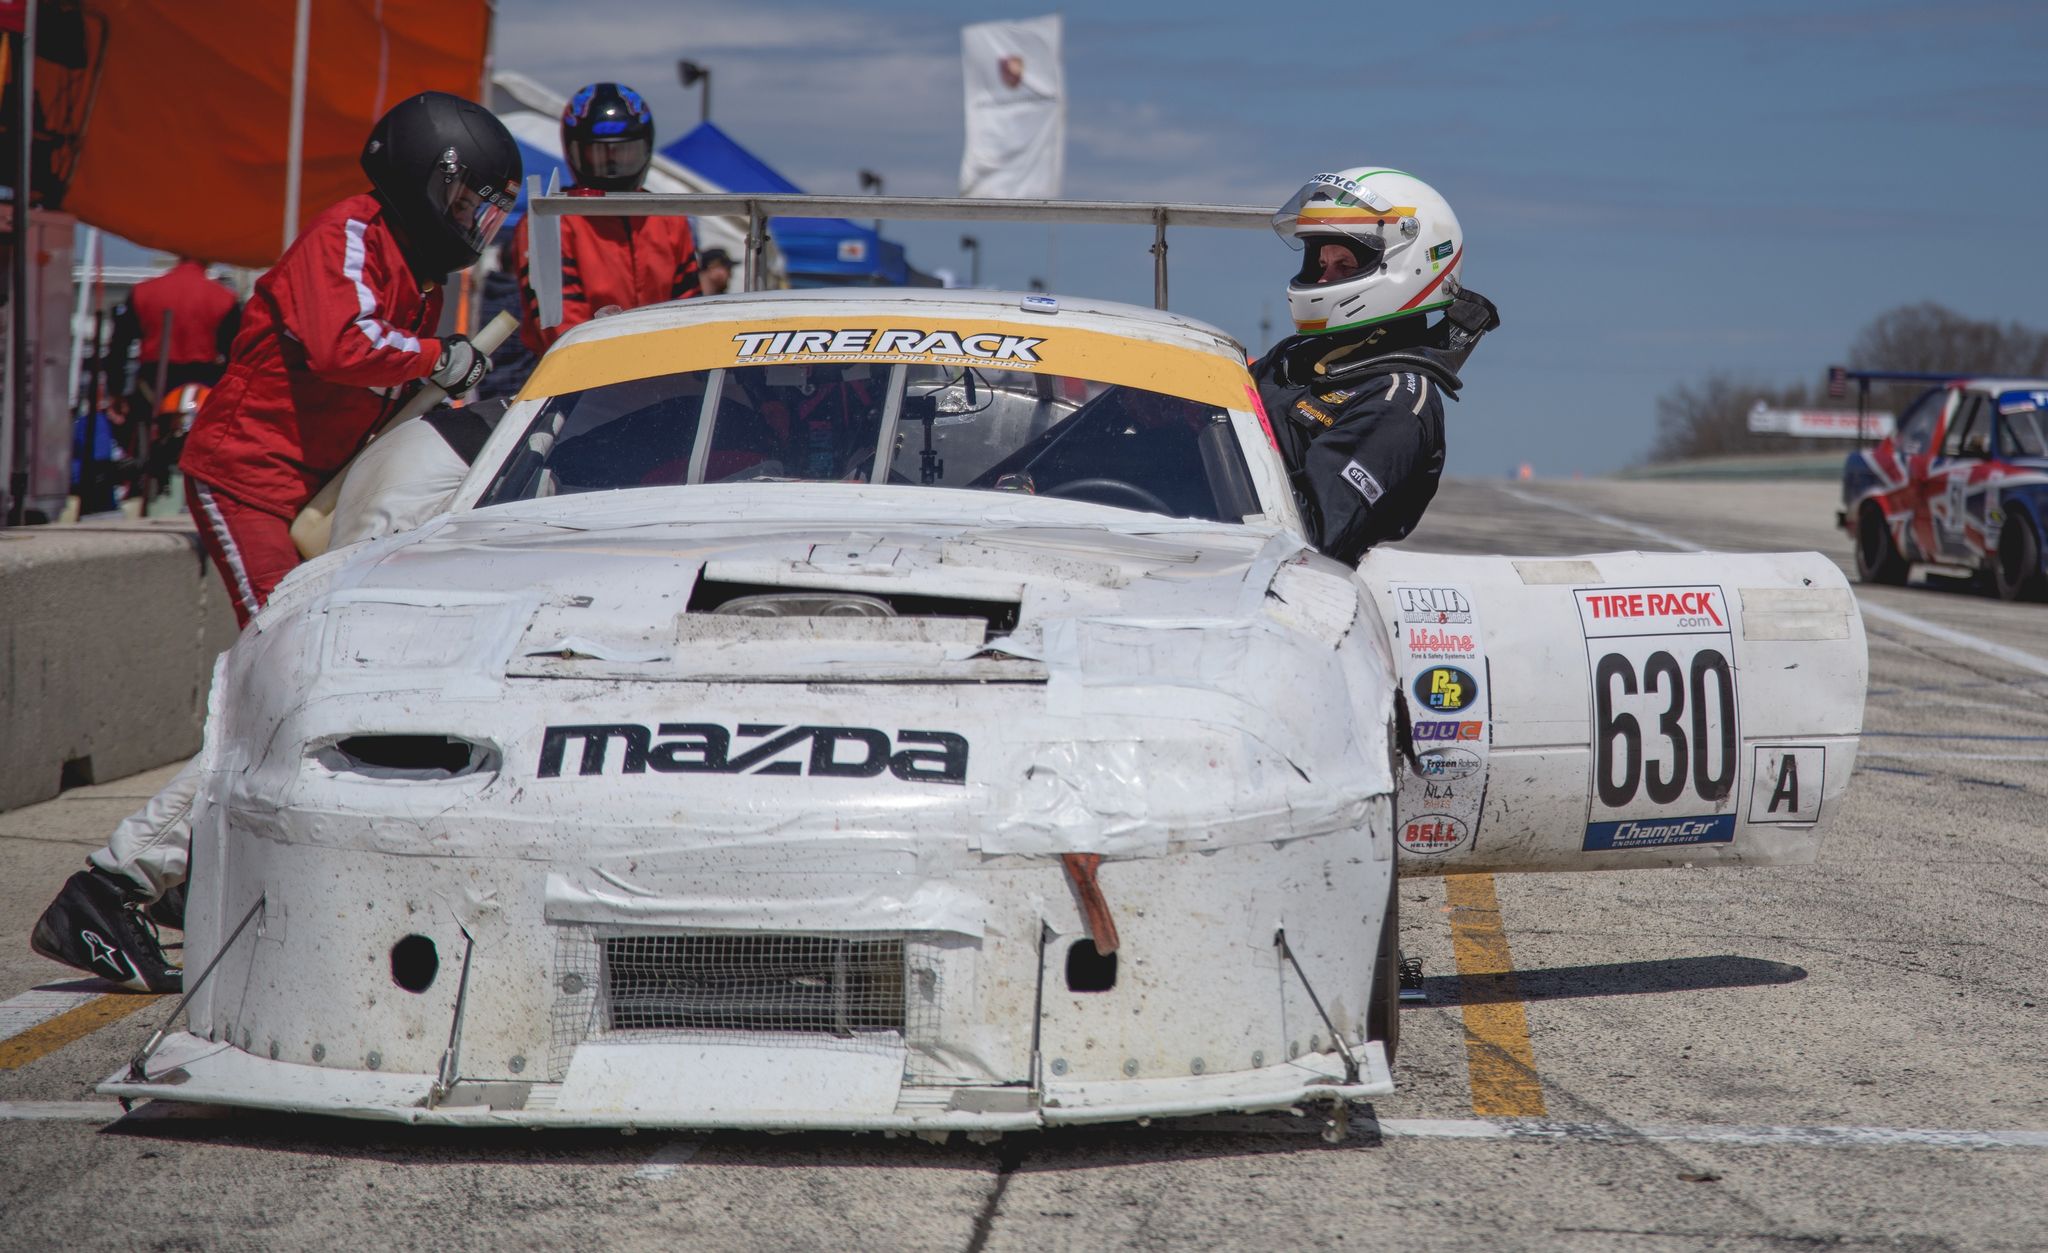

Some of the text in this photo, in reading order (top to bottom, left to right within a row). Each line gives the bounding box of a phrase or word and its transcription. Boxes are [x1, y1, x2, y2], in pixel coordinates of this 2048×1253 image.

[732, 329, 1048, 362] TIRE RACK
[1586, 592, 1724, 627] TIRE RACK
[1677, 616, 1710, 628] .com
[1428, 653, 1443, 661] Safety
[1444, 653, 1466, 661] Systems
[1596, 649, 1737, 807] 630
[1427, 759, 1457, 769] Frozen
[1768, 754, 1798, 813] A
[1405, 823, 1458, 843] BELL
[1612, 835, 1700, 847] ENDURANCE SERIES
[1613, 820, 1714, 843] ChampCar
